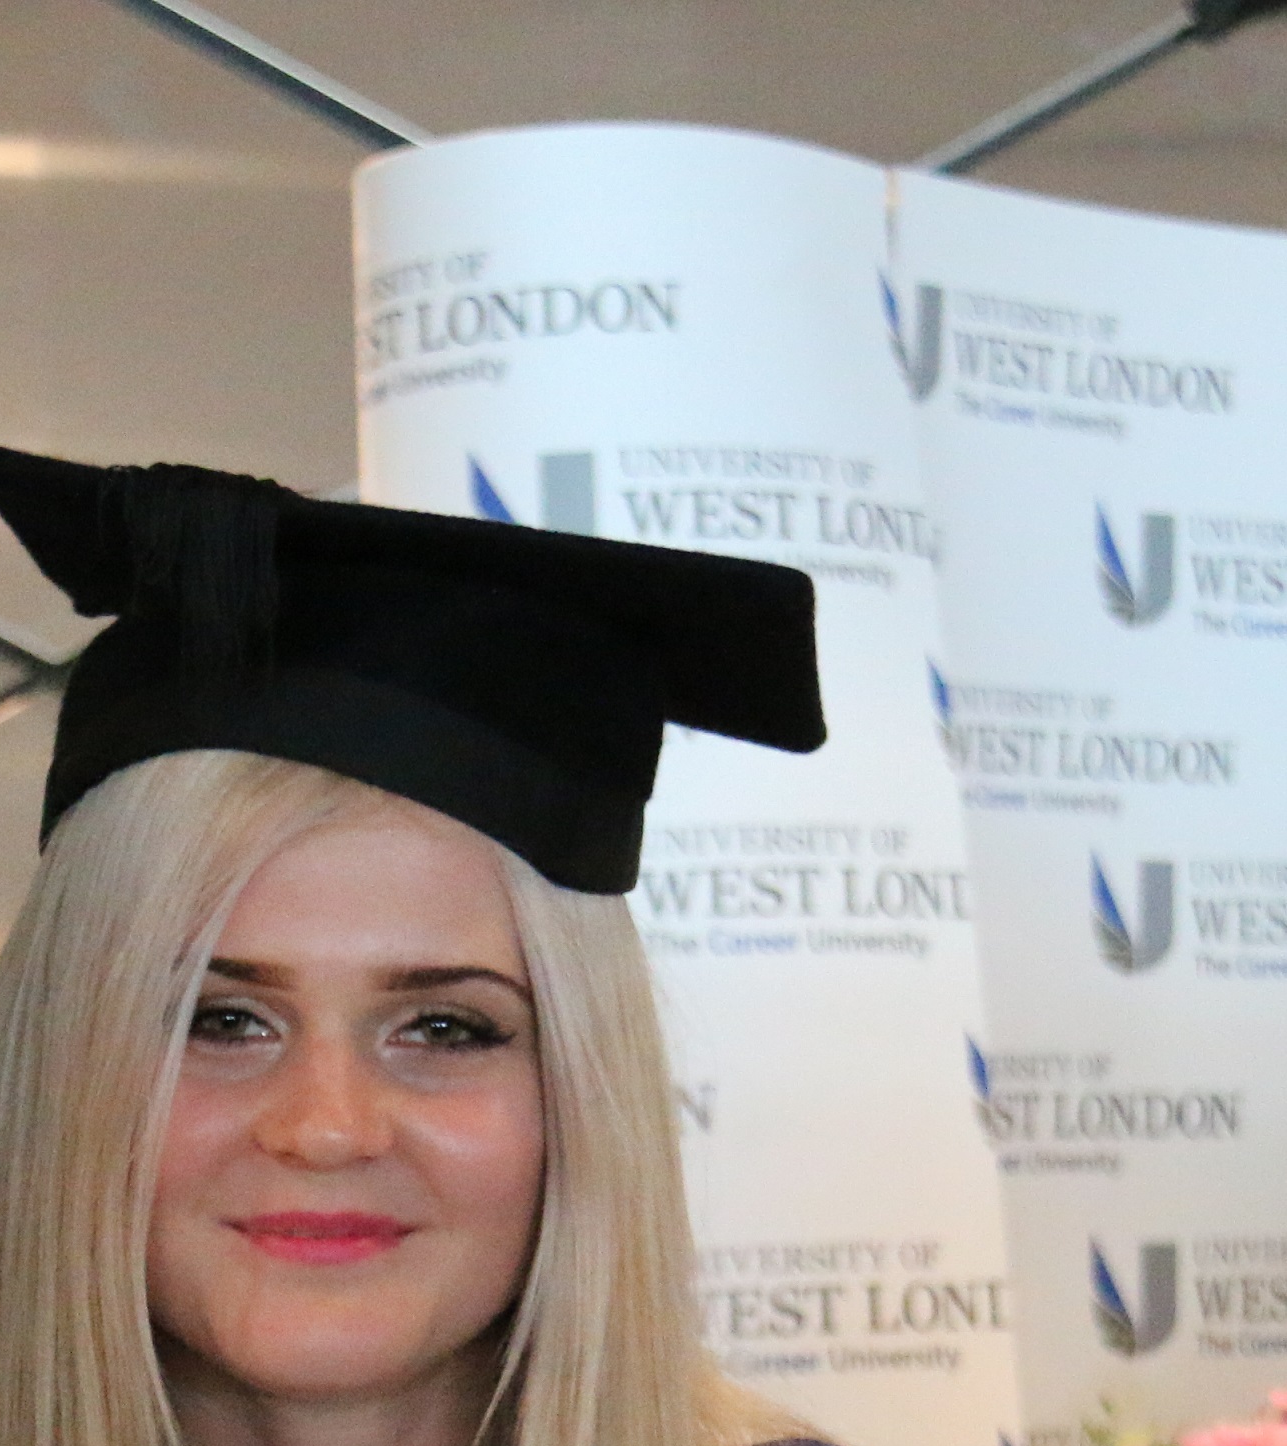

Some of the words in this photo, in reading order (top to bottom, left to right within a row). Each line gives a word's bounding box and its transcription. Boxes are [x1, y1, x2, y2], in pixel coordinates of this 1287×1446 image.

[417, 282, 681, 353] LONDON
[954, 331, 1055, 394] WEST
[1065, 349, 1236, 414] LONDON
[618, 446, 832, 484] UNIVERSITY
[840, 456, 876, 489] OF
[621, 489, 796, 541] WEST
[1191, 553, 1287, 606] WES
[1057, 732, 1237, 786] LONDON
[870, 827, 909, 856] OF
[640, 865, 821, 918] WEST
[840, 865, 969, 920] LON
[645, 927, 698, 954] The
[708, 928, 799, 956] Career
[808, 928, 929, 960] University
[1191, 898, 1287, 945] WES
[1053, 1089, 1242, 1140] LONDON
[897, 1237, 943, 1272] OF
[723, 1281, 845, 1338] EST
[865, 1279, 1007, 1334] LON
[1194, 1276, 1287, 1323] WES
[827, 1343, 962, 1373] University
